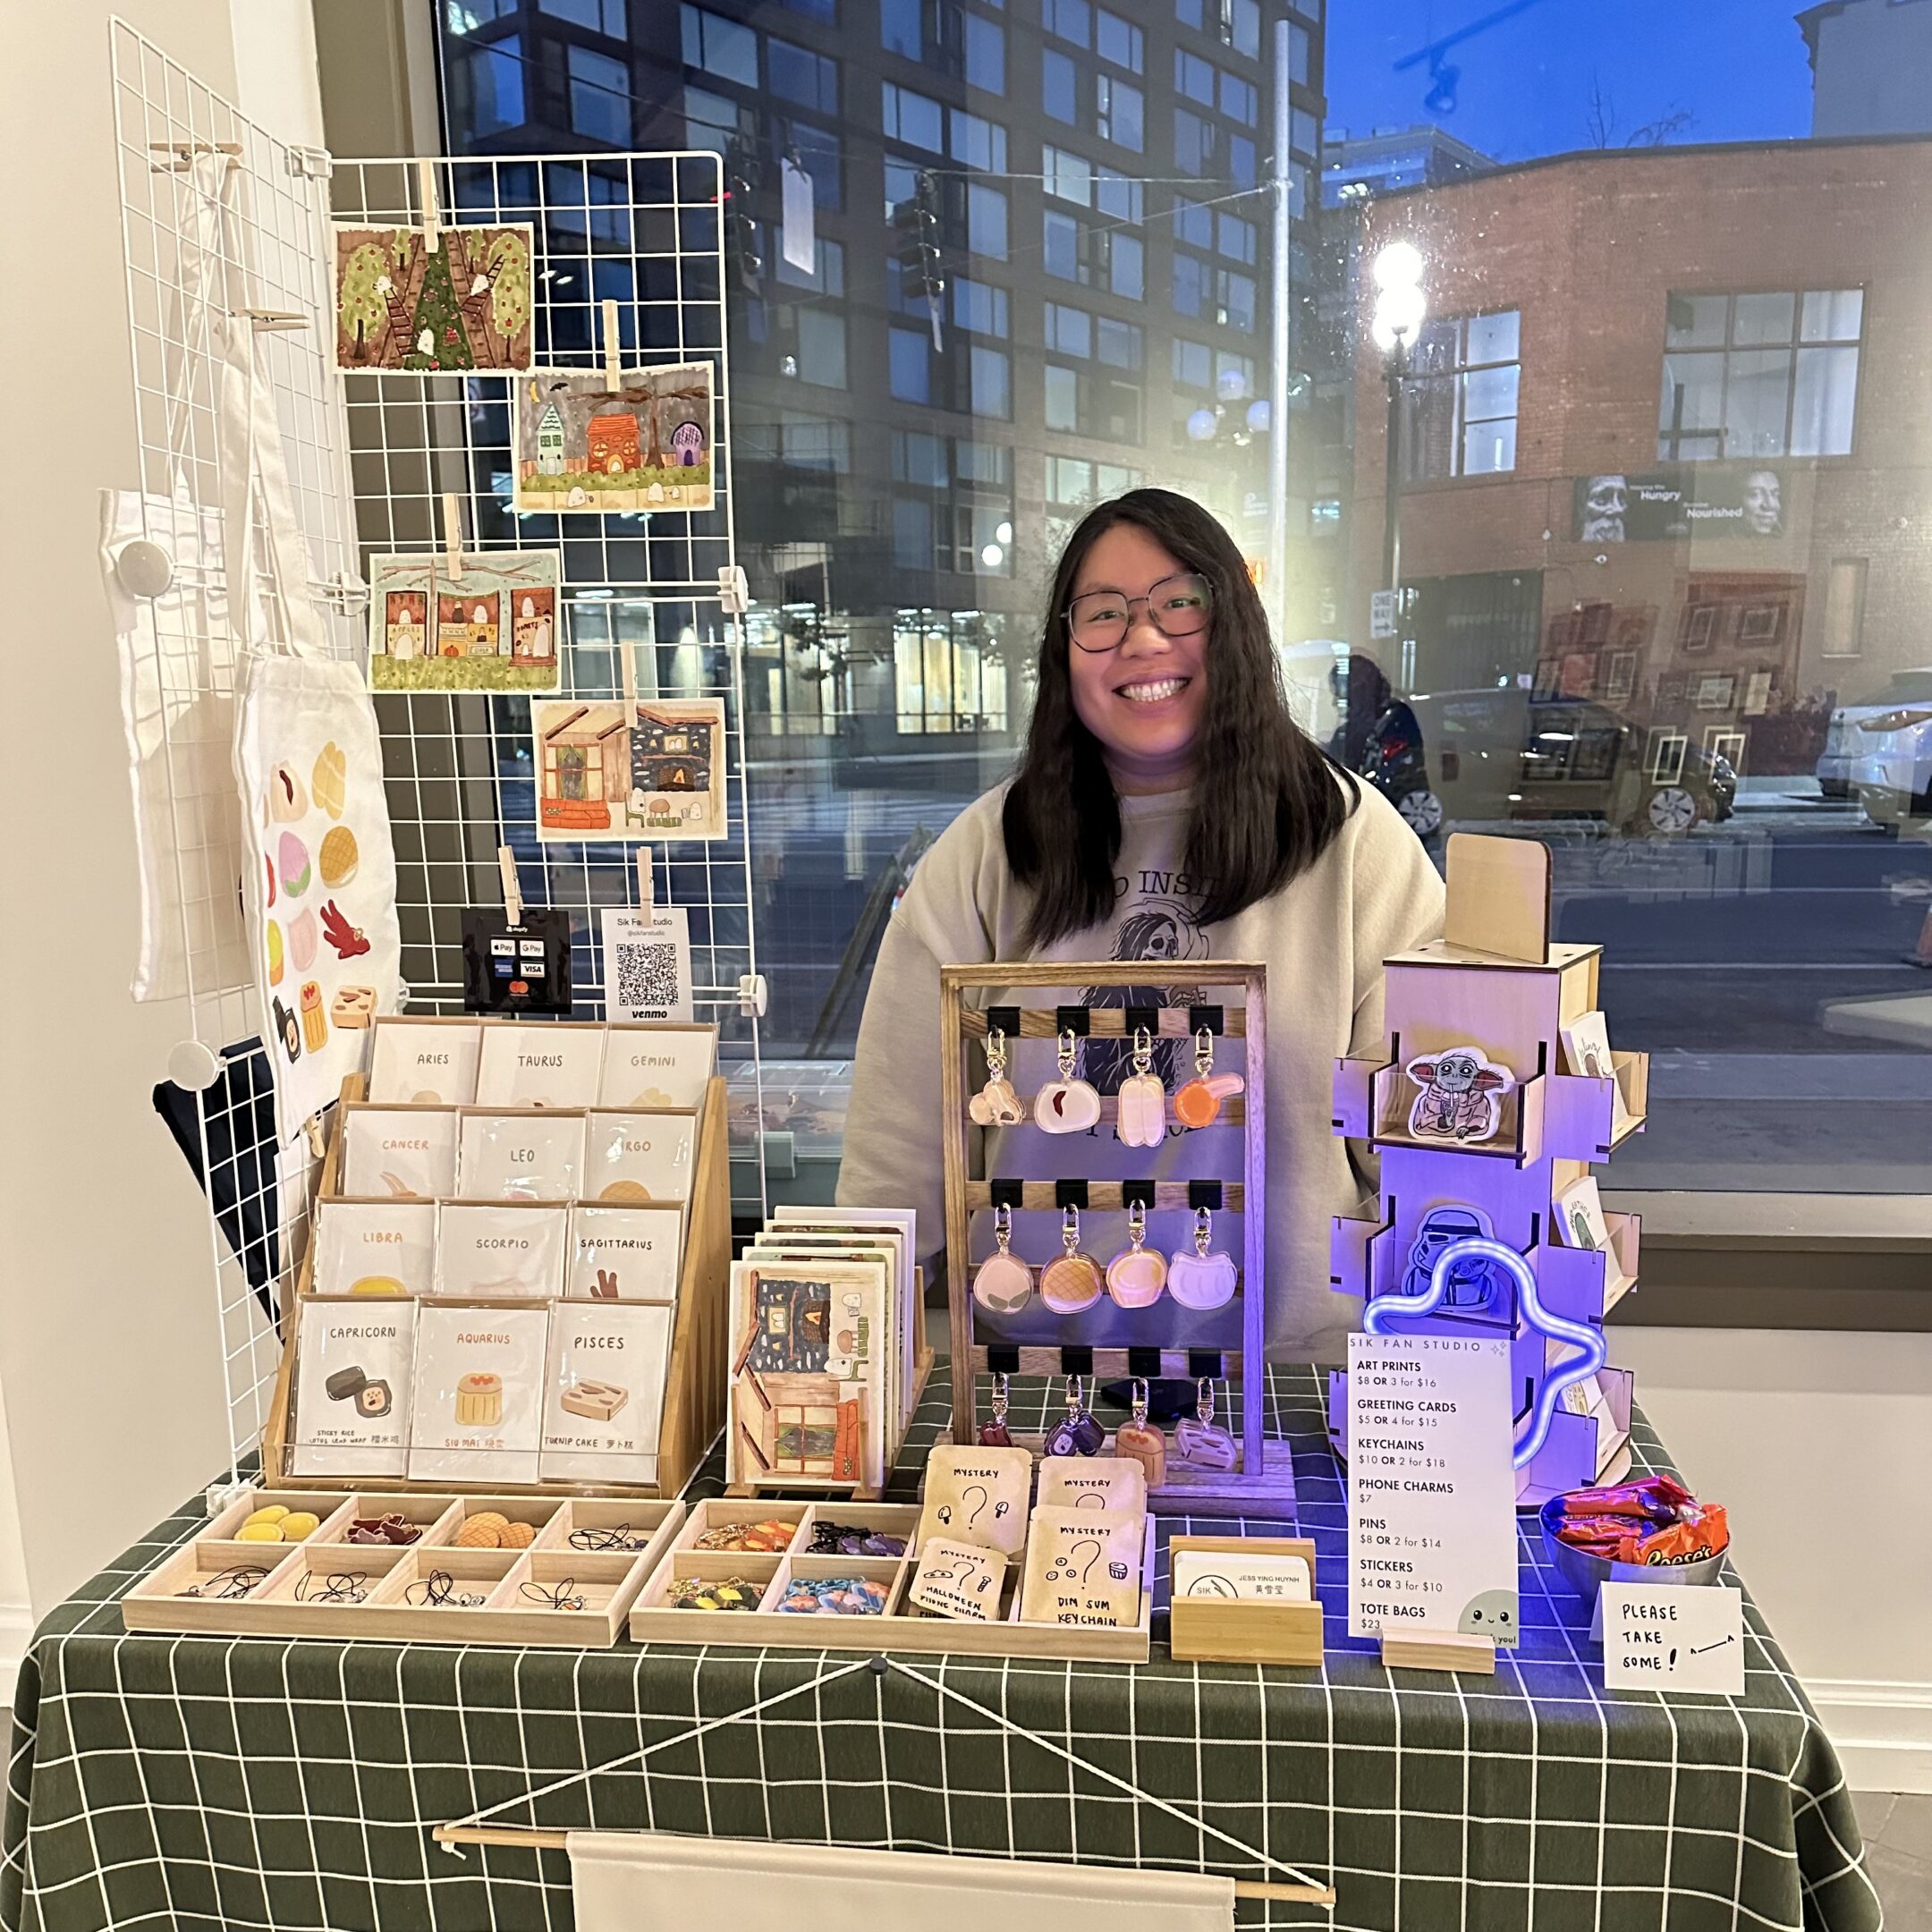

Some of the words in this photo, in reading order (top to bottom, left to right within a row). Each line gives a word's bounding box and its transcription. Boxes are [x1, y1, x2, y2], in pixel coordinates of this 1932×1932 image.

[1640, 490, 1682, 502] Hungry
[1687, 507, 1743, 519] Nourished
[617, 918, 630, 926] Sik
[653, 918, 673, 926] tudio
[500, 944, 513, 952] Pay
[631, 1010, 668, 1019] venmo
[417, 1054, 449, 1064] ARIES
[518, 1055, 563, 1067] TAURUS
[631, 1055, 675, 1067] GEMINI
[382, 1140, 429, 1150] CANCER
[611, 1141, 651, 1152] IRGO
[510, 1149, 535, 1163] LEO
[363, 1232, 402, 1243] LIBRA
[476, 1238, 529, 1250] SCORPIO
[580, 1238, 653, 1250] SAGITTARIUS
[330, 1326, 396, 1339] CAPRICORN
[456, 1333, 511, 1344] AQUARIUS
[574, 1336, 624, 1350] PISCES
[1350, 1338, 1374, 1347] SIK
[1384, 1339, 1413, 1348] FAN
[1423, 1340, 1481, 1352] STUDIO
[1357, 1360, 1378, 1371] ART
[1382, 1361, 1421, 1373] PRINTS
[1357, 1376, 1370, 1386] $8
[1373, 1376, 1387, 1386] OR
[1391, 1377, 1397, 1387] 3
[1401, 1377, 1413, 1387] for
[1417, 1377, 1436, 1388] $16
[1358, 1399, 1414, 1411] GREETING
[1418, 1402, 1457, 1413] CARDS
[1358, 1414, 1370, 1426] $5
[1374, 1415, 1388, 1426] OR
[1392, 1415, 1398, 1426] 4
[1402, 1415, 1415, 1427] for
[1418, 1416, 1437, 1428] $15
[445, 1438, 459, 1447] SIU
[462, 1438, 479, 1447] MAI
[545, 1436, 572, 1445] TURNIP
[576, 1438, 598, 1447] CAKE
[1358, 1438, 1424, 1451] KEYCHAINS
[1359, 1454, 1378, 1466] $10
[1381, 1455, 1395, 1466] OR
[1399, 1456, 1405, 1466] 2
[1409, 1455, 1421, 1467] for
[1426, 1456, 1445, 1468] $18
[953, 1468, 999, 1479] MYSTERY
[1063, 1479, 1111, 1488] MYSTERY
[1359, 1479, 1400, 1491] PHONE
[1403, 1481, 1453, 1494] CHARMS
[1359, 1492, 1371, 1504] $7
[1359, 1518, 1386, 1530] PINS
[1059, 1525, 1112, 1538] MYSTERY
[1360, 1533, 1373, 1545] $8
[1376, 1535, 1391, 1545] OR
[1394, 1536, 1401, 1546] 2
[1404, 1536, 1418, 1546] for
[1420, 1537, 1441, 1548] $14
[940, 1549, 986, 1563] MYSTERY
[1360, 1559, 1413, 1572] STICKERS
[1197, 1587, 1212, 1595] SIK
[1360, 1578, 1373, 1589] $4
[1377, 1579, 1392, 1589] OR
[1394, 1580, 1402, 1590] 3
[1405, 1580, 1419, 1590] for
[1422, 1580, 1443, 1592] $10
[927, 1586, 982, 1611] HALLOWEEN
[1058, 1597, 1078, 1608] DIM
[1086, 1599, 1110, 1610] SUM
[1360, 1603, 1389, 1615] TOTE
[1392, 1605, 1426, 1618] BAGS
[1622, 1604, 1677, 1621] PLEASE
[1057, 1614, 1117, 1627] KEYCHAIN
[1360, 1618, 1380, 1630] $23
[1498, 1635, 1516, 1644] you!
[1623, 1630, 1663, 1644] TAKE
